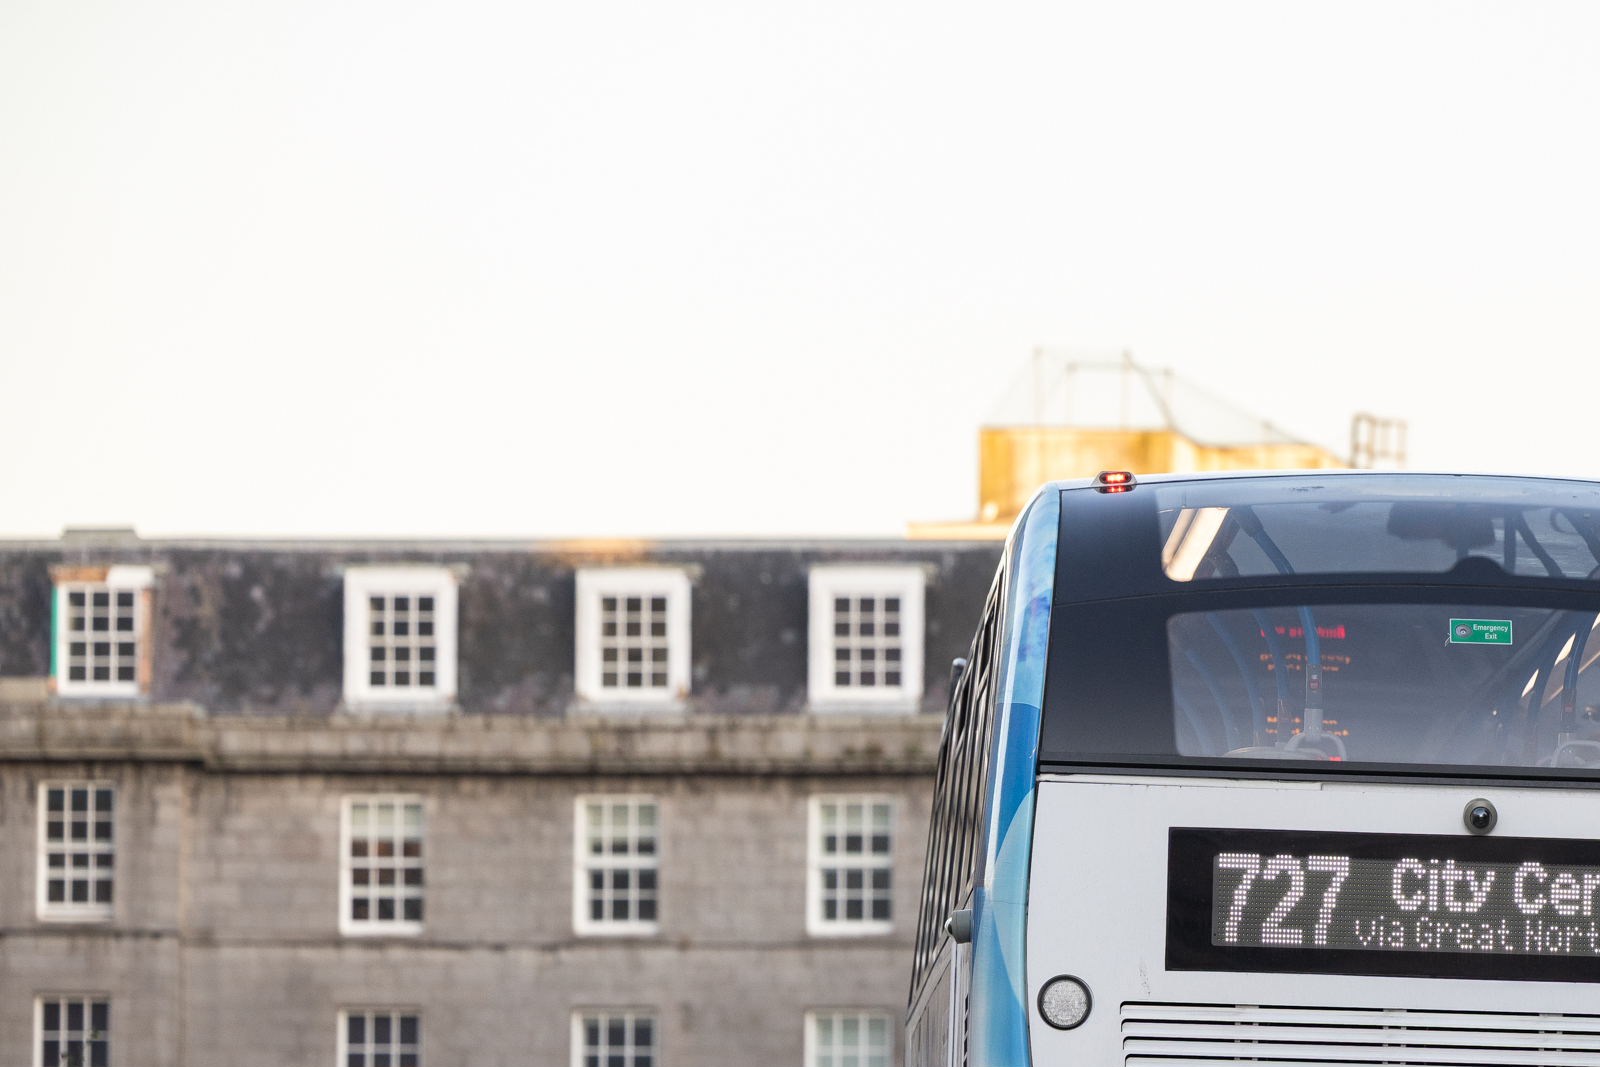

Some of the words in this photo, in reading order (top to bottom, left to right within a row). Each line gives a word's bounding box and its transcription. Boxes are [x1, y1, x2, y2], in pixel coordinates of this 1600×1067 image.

[1473, 624, 1508, 633] Emergency
[1219, 853, 1349, 943] 727
[1393, 858, 1495, 913] City
[1355, 915, 1404, 947] via
[1416, 916, 1513, 951] Great
